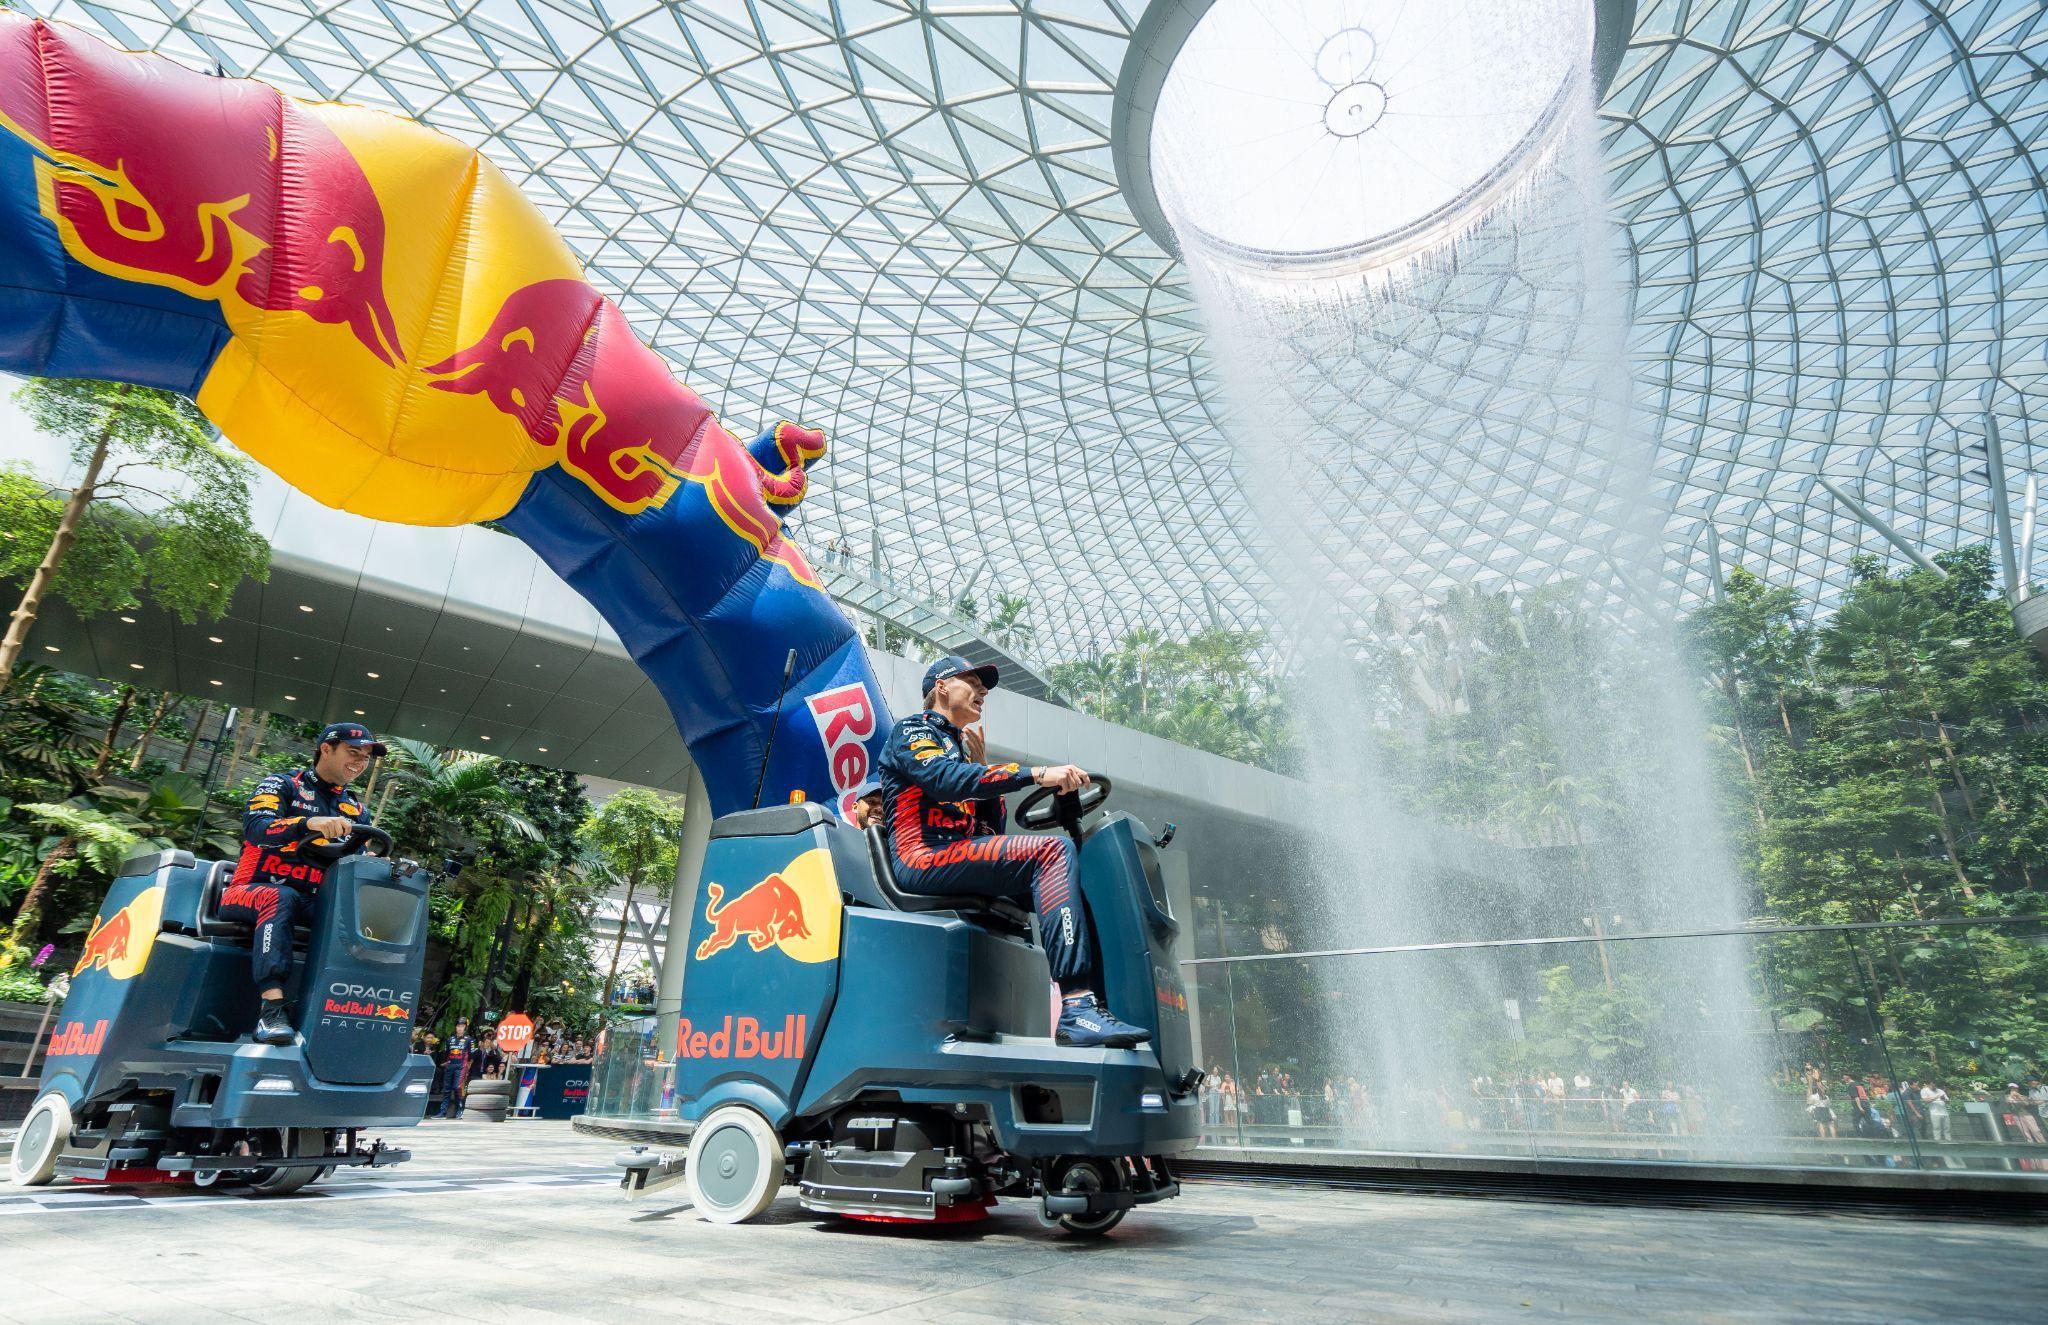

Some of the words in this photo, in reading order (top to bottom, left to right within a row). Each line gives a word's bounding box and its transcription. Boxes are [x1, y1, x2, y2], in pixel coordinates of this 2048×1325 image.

[262, 854, 309, 880] Red
[329, 982, 414, 1005] ORACLE
[324, 998, 350, 1014] Red
[350, 1001, 375, 1016] Bull
[321, 1018, 407, 1034] RACING
[498, 1025, 532, 1041] STOP
[676, 1015, 733, 1059] Red
[734, 1014, 806, 1059] Bull
[565, 1079, 590, 1088] ORA
